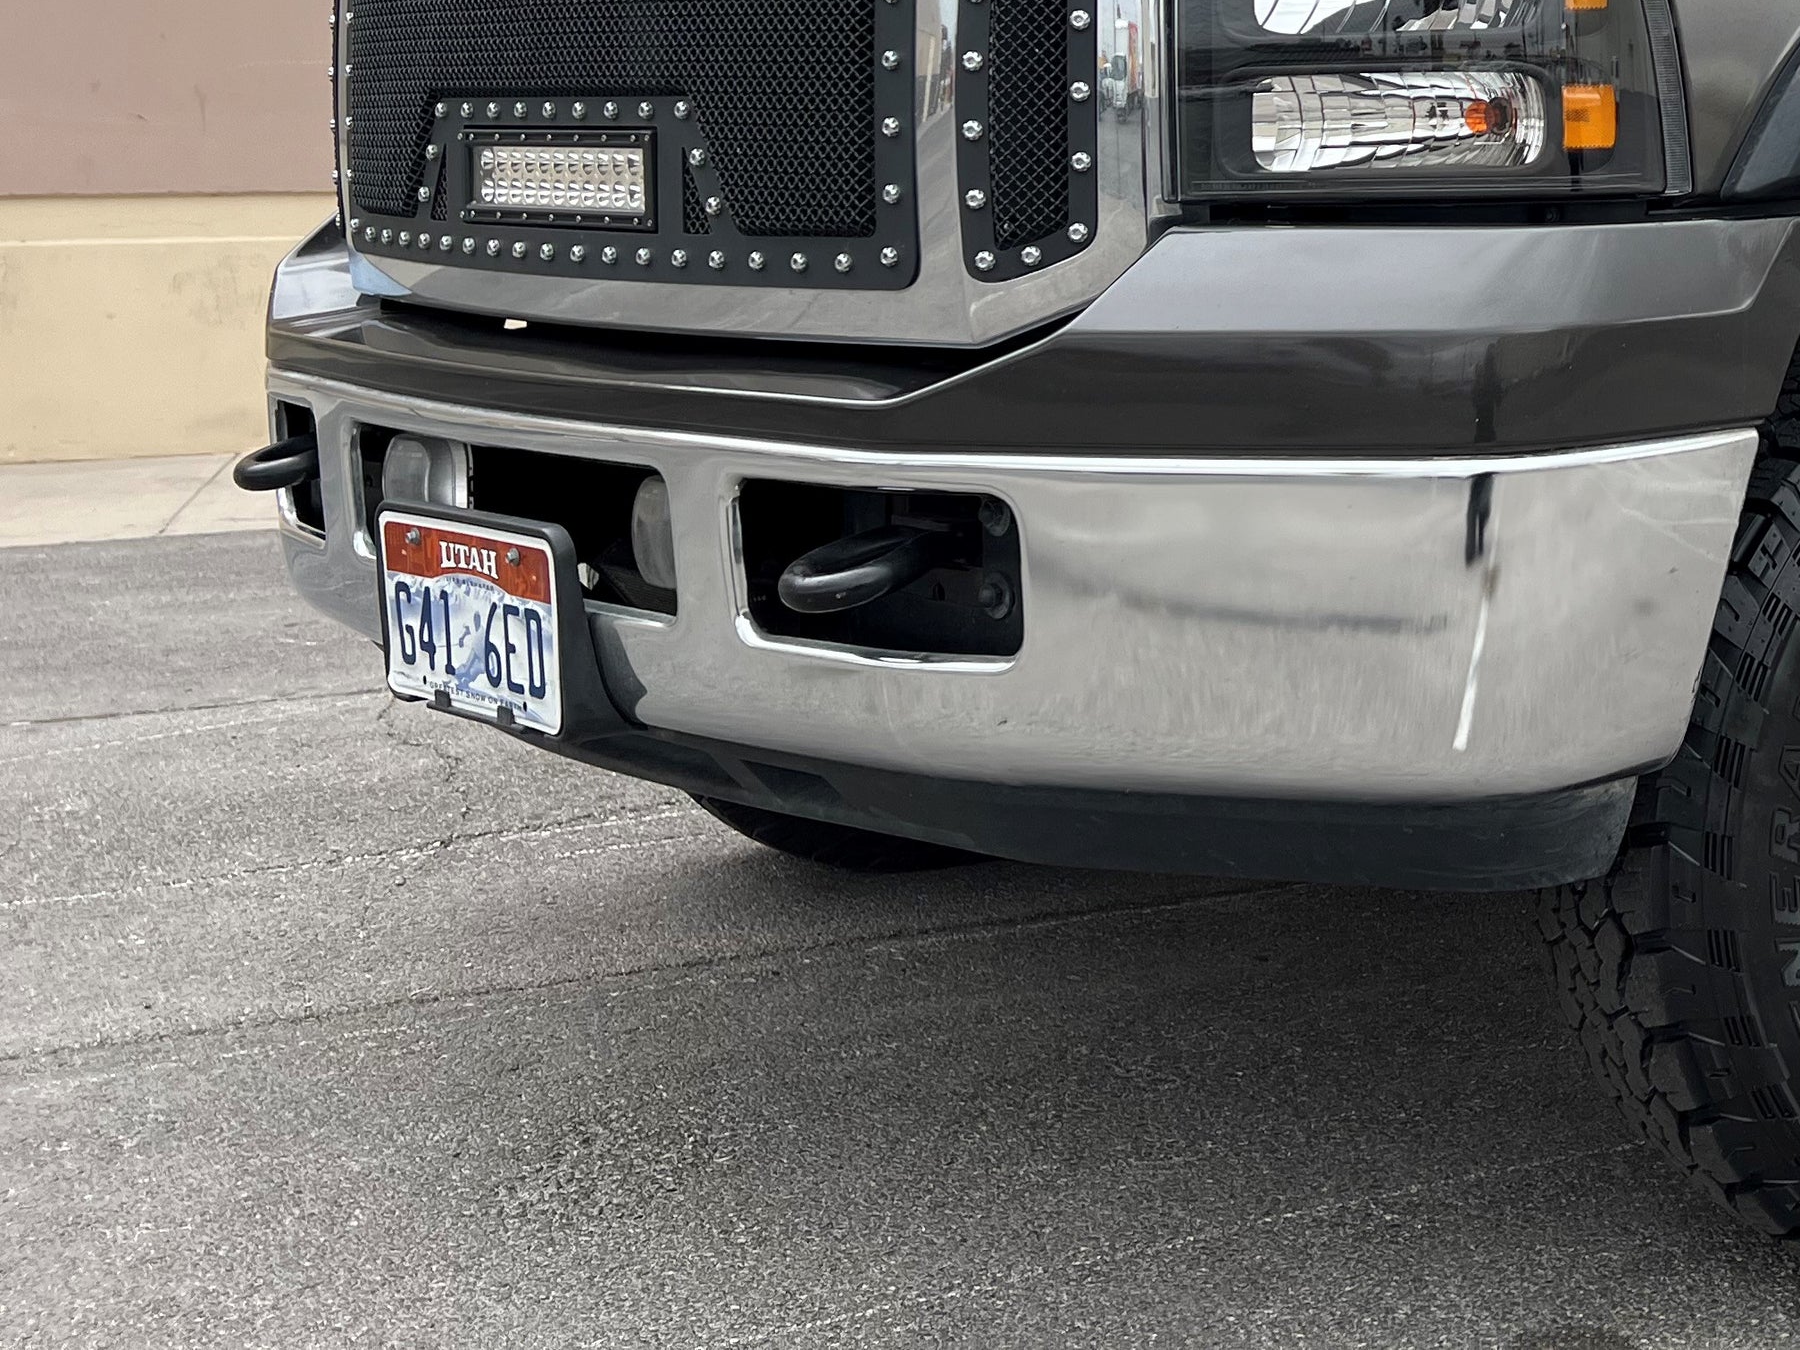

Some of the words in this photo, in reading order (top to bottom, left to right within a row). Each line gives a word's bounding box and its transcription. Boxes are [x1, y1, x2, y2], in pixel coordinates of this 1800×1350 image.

[439, 541, 499, 580] UTAH
[394, 581, 456, 676] G41
[484, 601, 547, 700] 6ED
